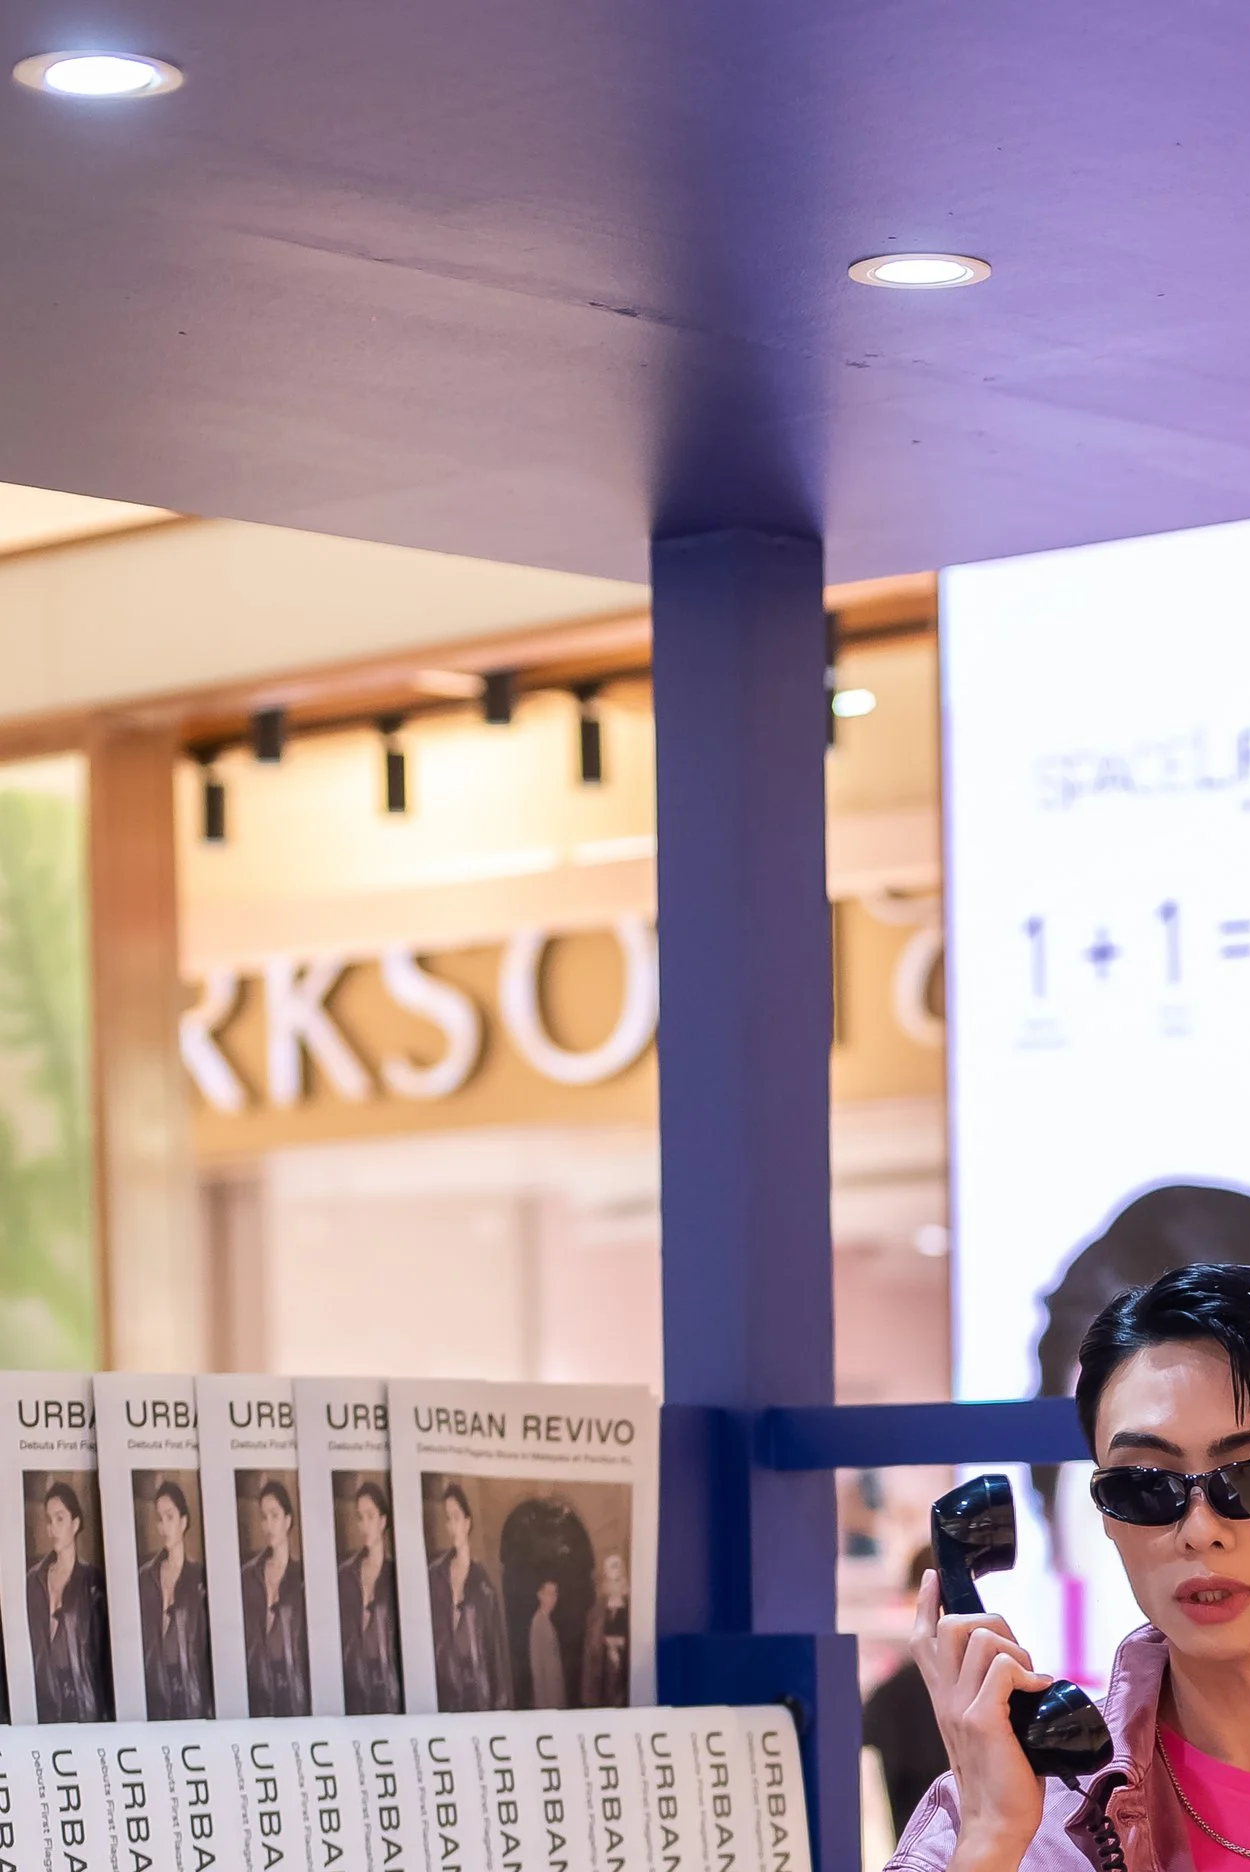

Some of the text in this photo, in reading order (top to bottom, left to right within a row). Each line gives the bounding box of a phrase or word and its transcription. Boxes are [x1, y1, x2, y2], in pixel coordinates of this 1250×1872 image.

[18, 1399, 96, 1428] URB
[126, 1400, 198, 1428] URB
[229, 1400, 294, 1428] URB
[326, 1403, 389, 1430] URB
[413, 1405, 636, 1447] URBAN REVIVO
[30, 1749, 46, 1799] Debuts
[39, 1801, 50, 1834] First
